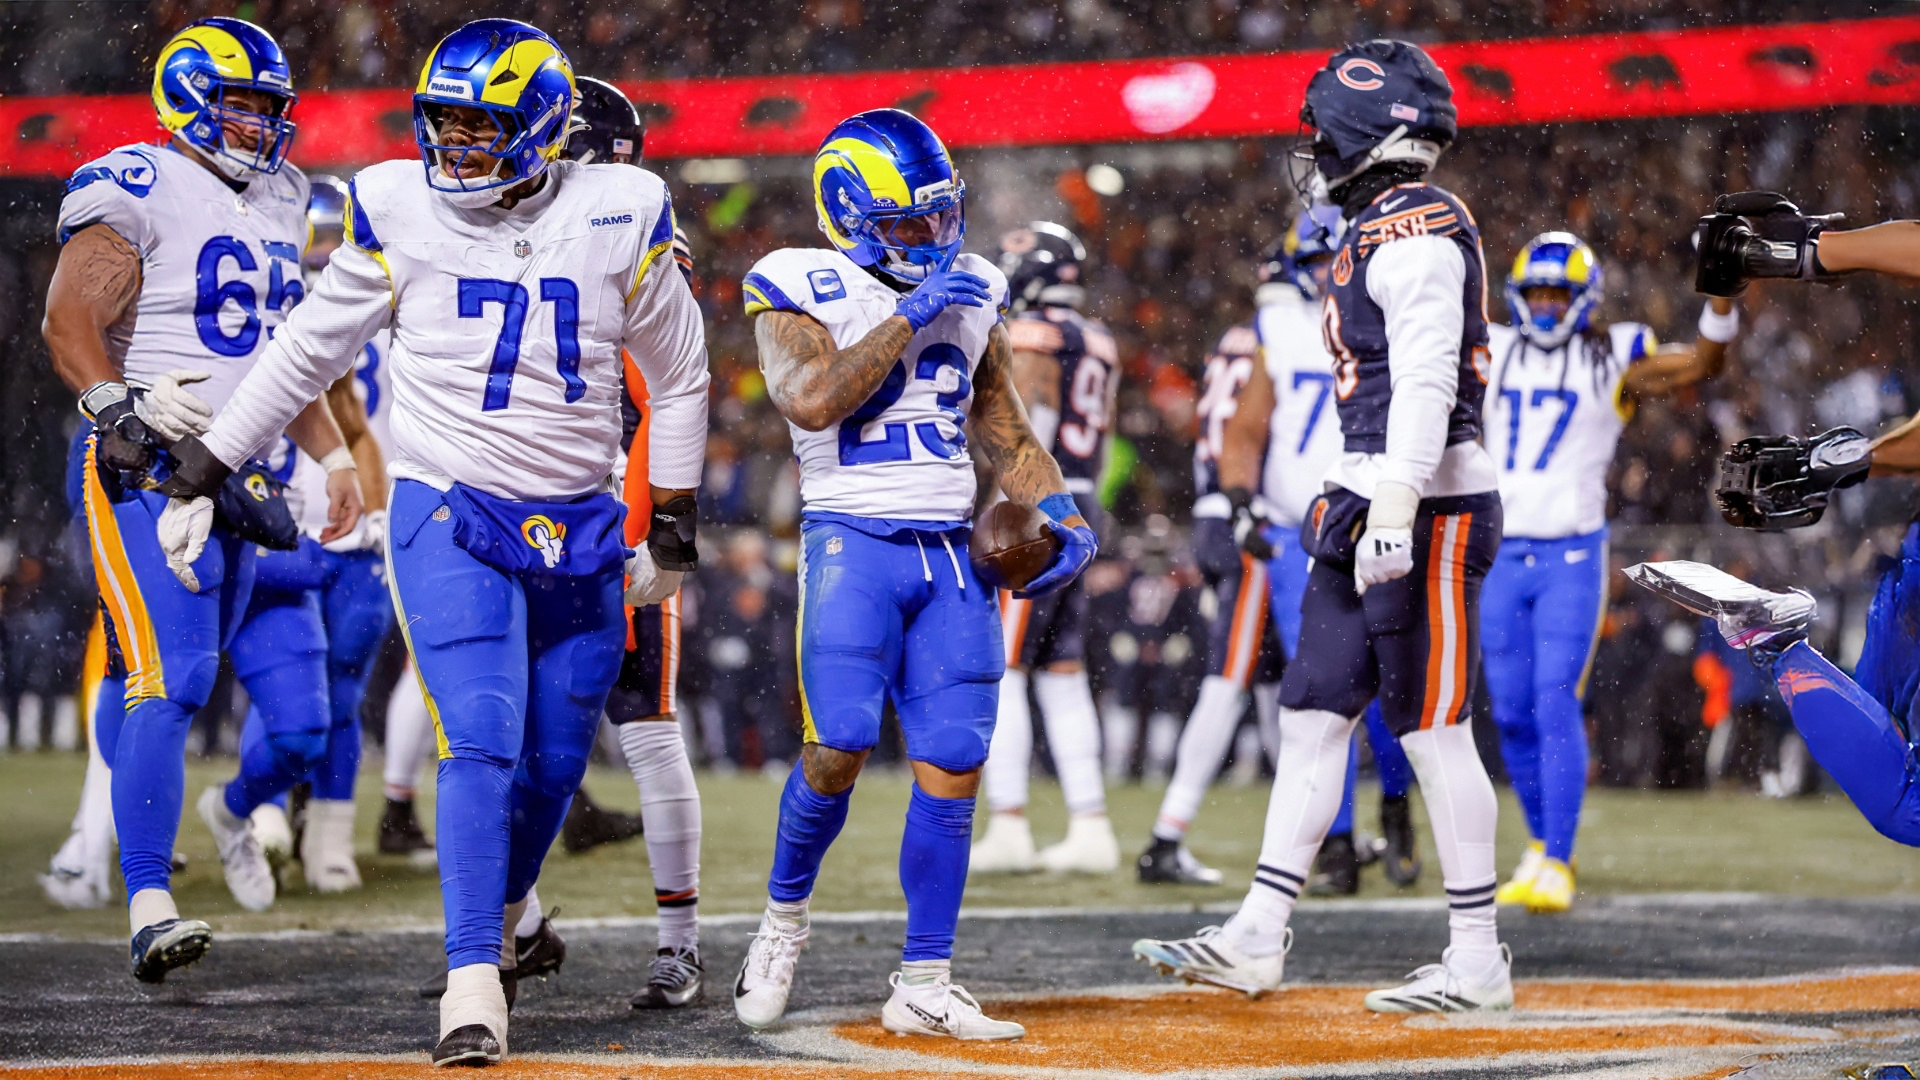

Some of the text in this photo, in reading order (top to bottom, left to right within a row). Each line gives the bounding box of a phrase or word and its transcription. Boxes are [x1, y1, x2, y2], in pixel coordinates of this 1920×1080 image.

[431, 83, 464, 94] RAMS
[590, 214, 633, 227] RAMS
[1380, 214, 1428, 243] GSH
[194, 236, 305, 357] 65
[457, 277, 587, 411] 71
[838, 342, 971, 466] 23
[1499, 389, 1578, 469] 17
